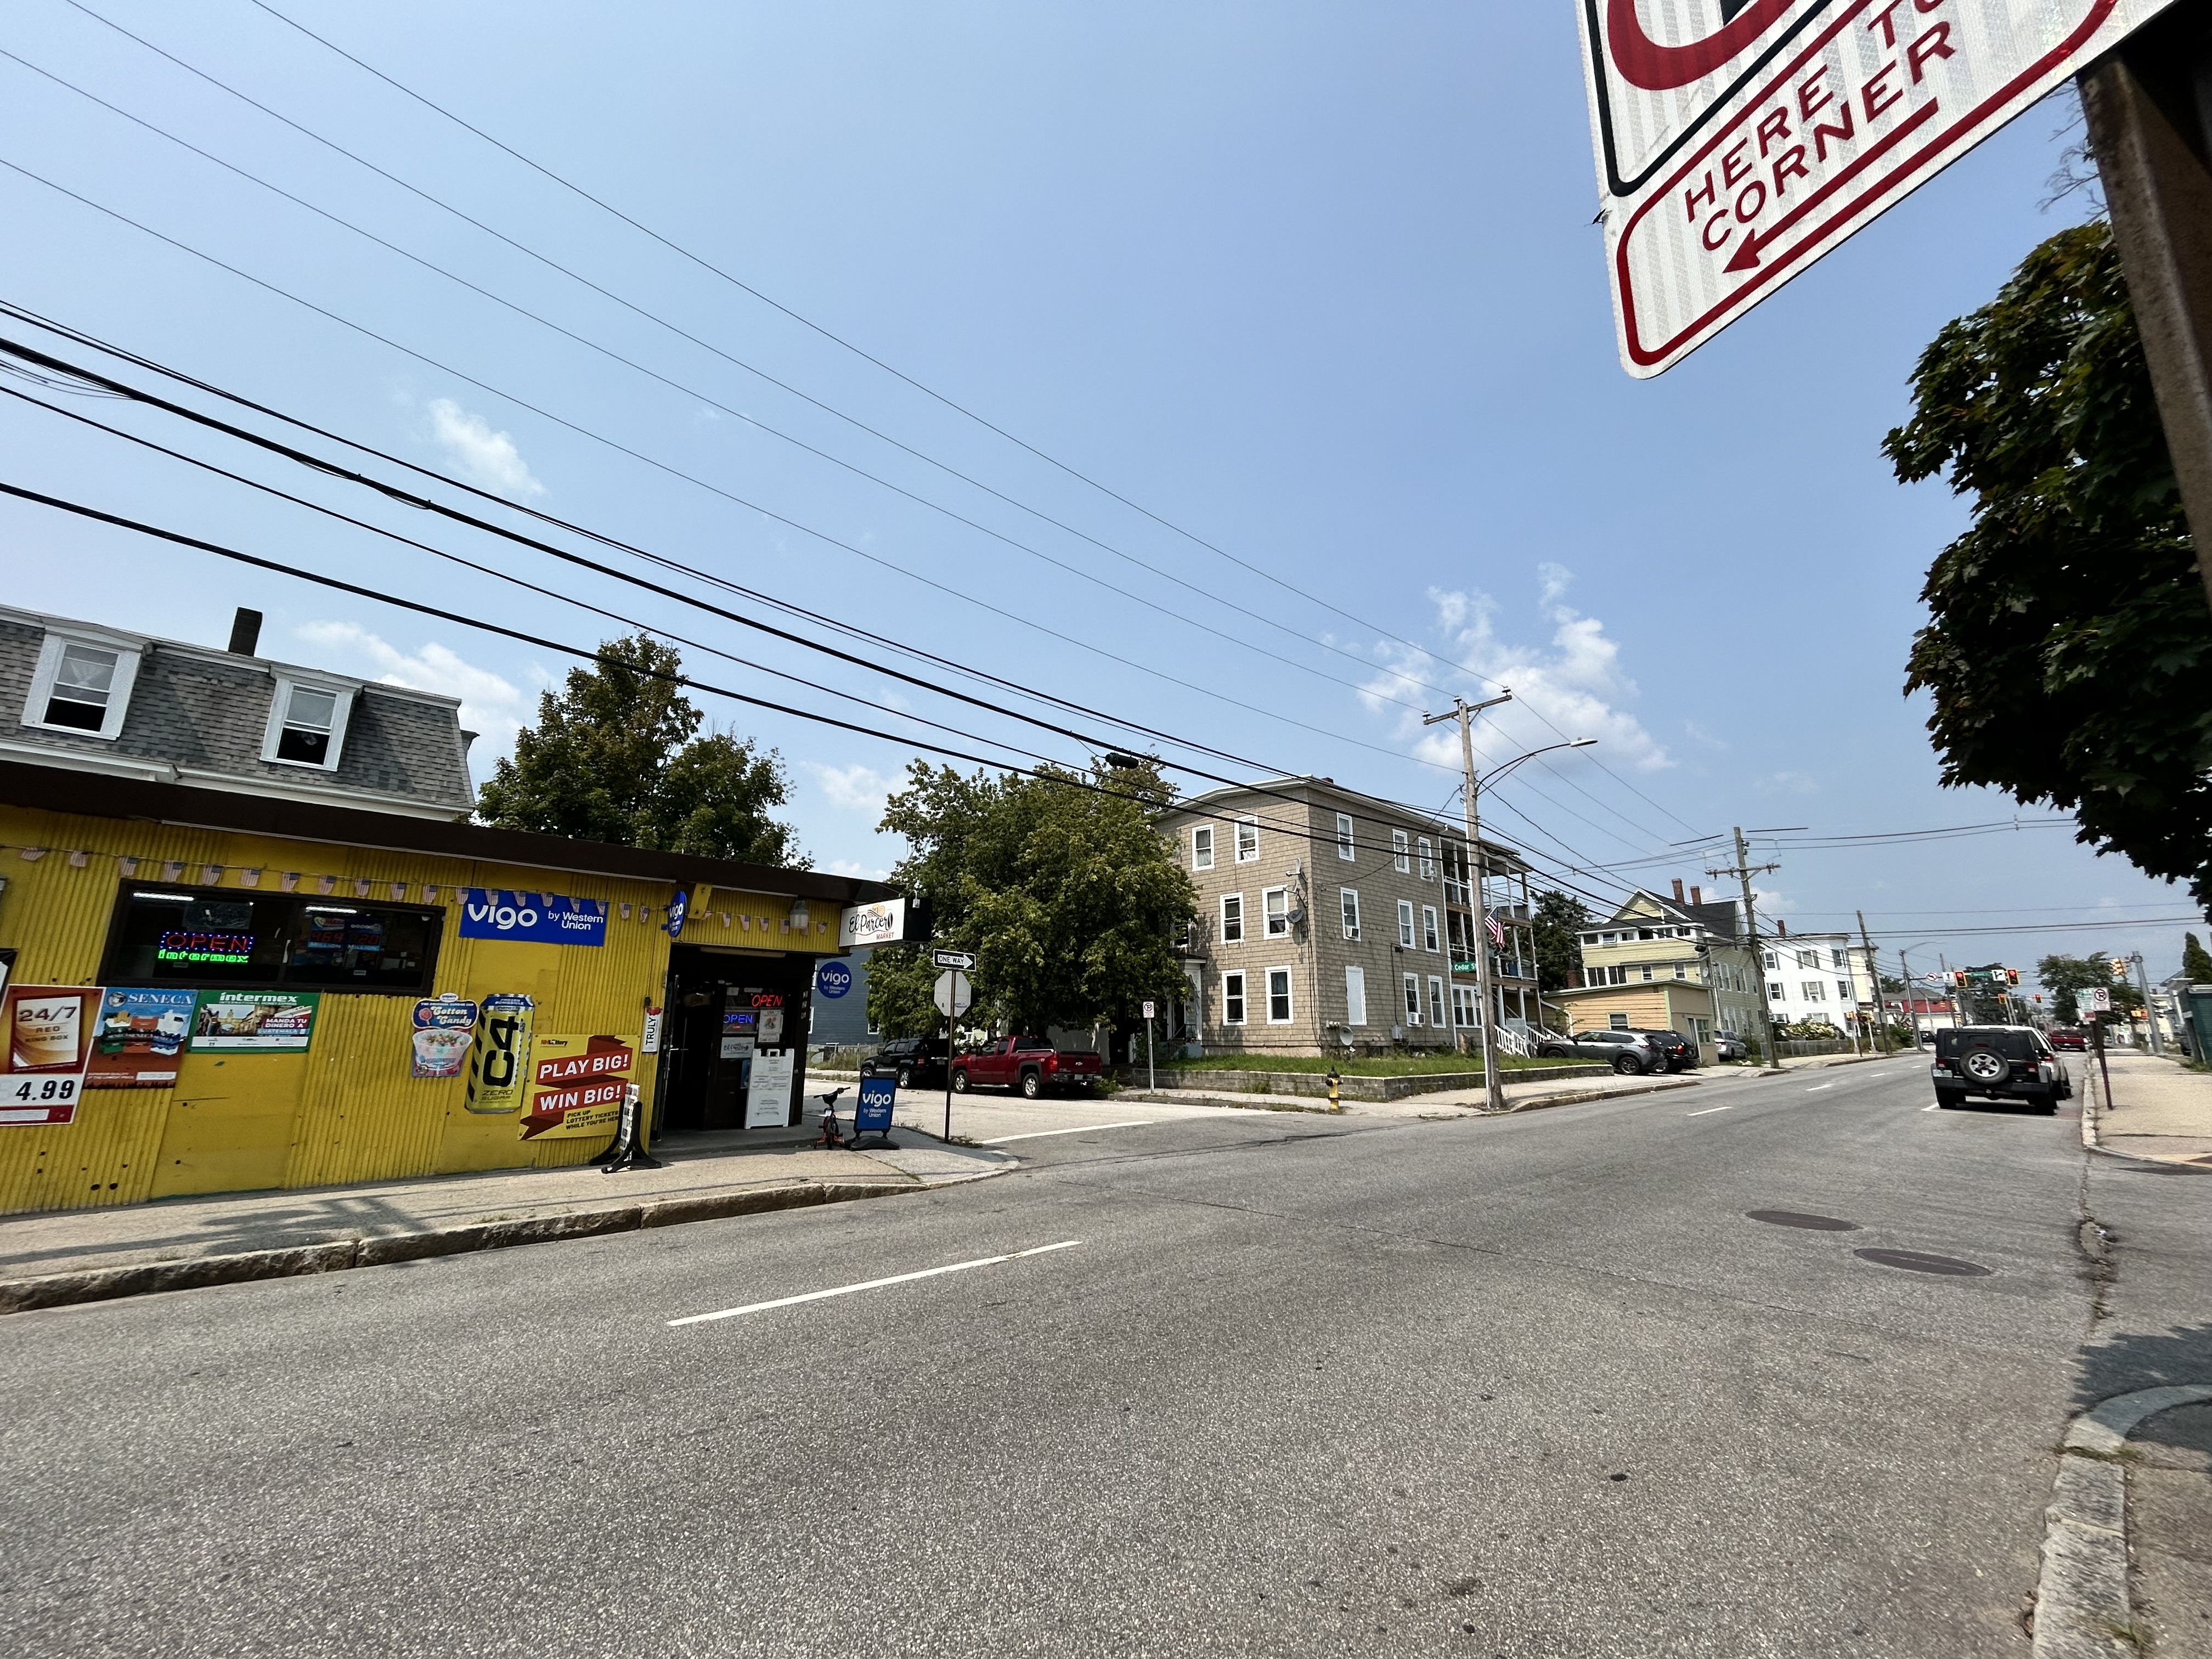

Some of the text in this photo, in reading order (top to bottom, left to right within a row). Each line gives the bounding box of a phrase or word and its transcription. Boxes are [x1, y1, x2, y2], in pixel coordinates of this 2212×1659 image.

[1685, 64, 1835, 222] HERE
[1702, 21, 1956, 251] CORNER
[467, 904, 603, 930] vigo by Western
[669, 902, 683, 920] vigo
[561, 920, 591, 930] Union
[849, 913, 860, 933] El
[167, 934, 247, 951] OPEN
[821, 970, 849, 985] vigo
[127, 993, 192, 1005] SENECA
[219, 992, 297, 1002] intermex
[752, 995, 783, 1007] OPEN
[18, 1006, 77, 1023] 24/7
[430, 1006, 467, 1015] Cotton
[723, 1014, 753, 1024] OPEN
[437, 1015, 472, 1025] Candy
[645, 1017, 657, 1046] TRULY
[539, 1054, 629, 1079] PLAY BIG!
[16, 1079, 75, 1101] 4.99
[540, 1085, 621, 1111] WIN BIG!
[862, 1090, 891, 1107] vigo
[566, 1110, 618, 1124] LOTTERY TICKETS
